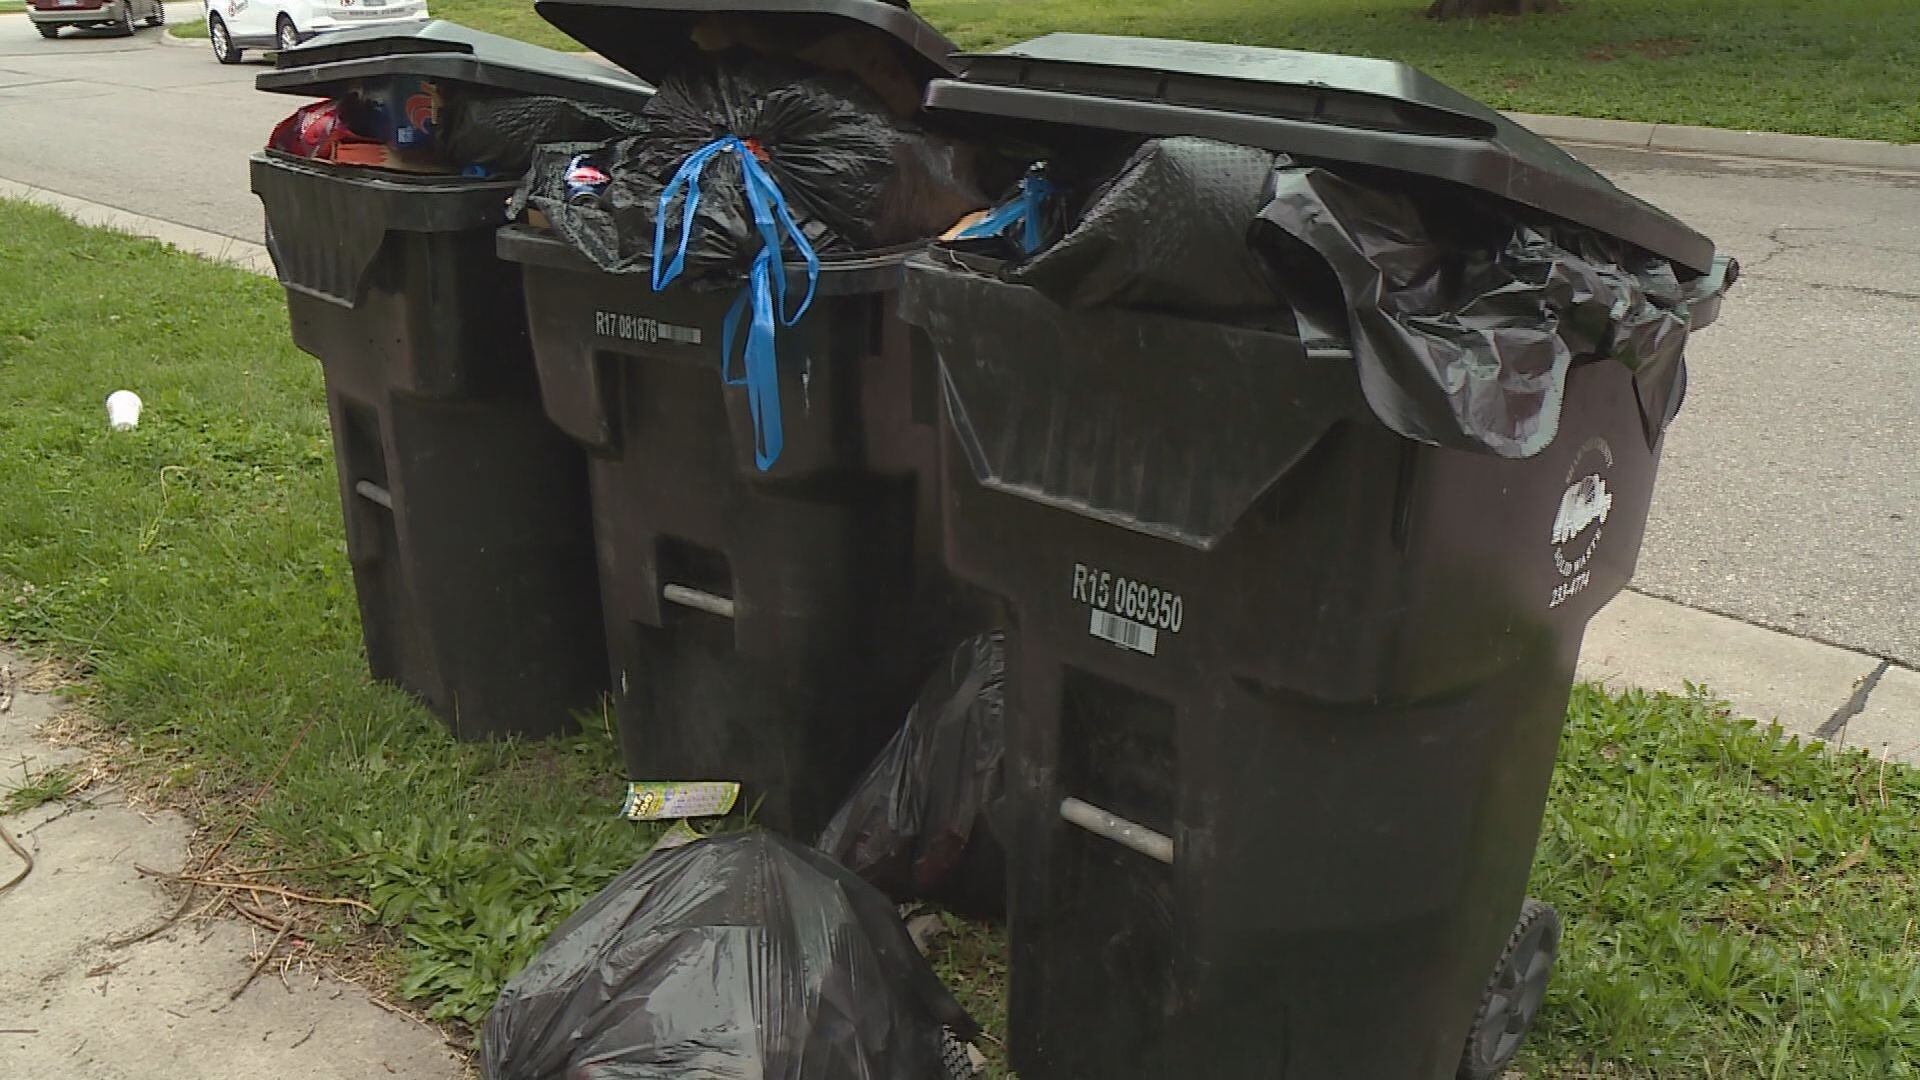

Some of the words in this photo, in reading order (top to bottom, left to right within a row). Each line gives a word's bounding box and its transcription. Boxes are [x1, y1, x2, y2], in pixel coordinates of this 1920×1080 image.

[595, 311, 617, 336] R17
[1072, 563, 1111, 609] R15
[1114, 577, 1183, 633] 069350
